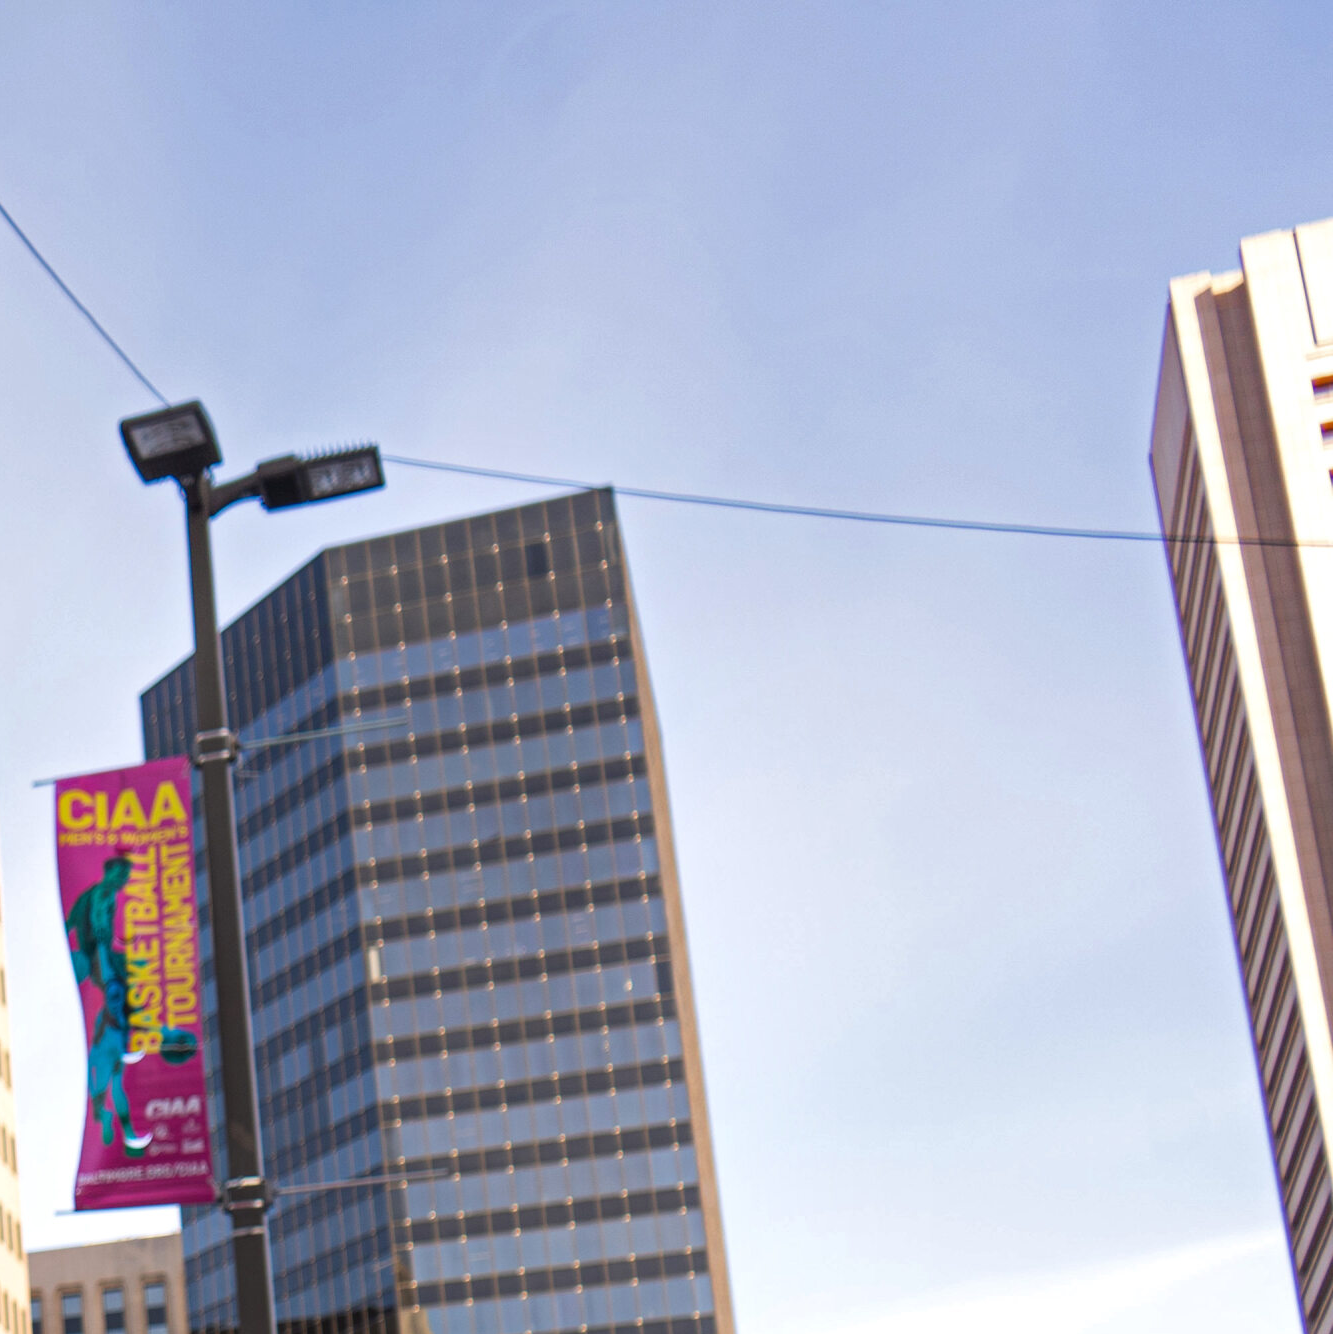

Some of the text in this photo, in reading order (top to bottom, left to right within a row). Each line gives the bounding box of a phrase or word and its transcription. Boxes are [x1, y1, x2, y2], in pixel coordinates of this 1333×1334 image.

[58, 782, 188, 830] CIAA
[124, 843, 163, 1055] BASKETBALL
[159, 841, 199, 1029] TOURNAMENT
